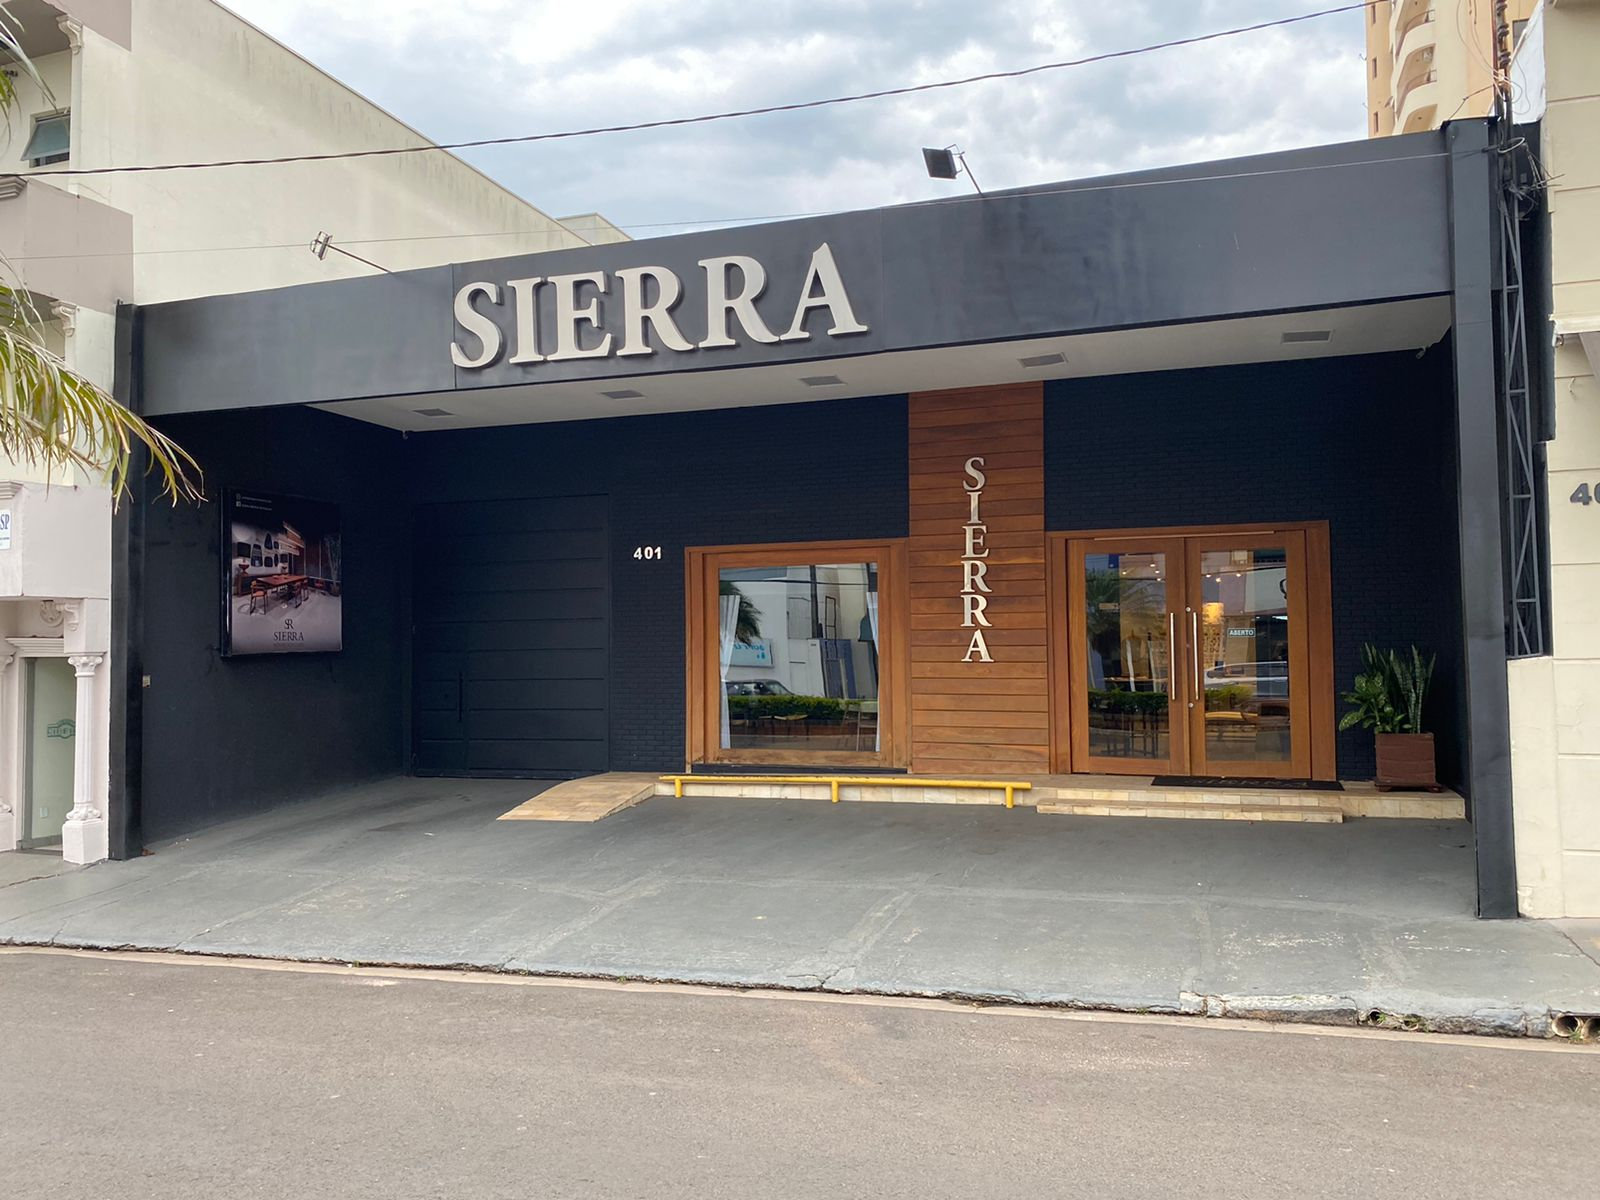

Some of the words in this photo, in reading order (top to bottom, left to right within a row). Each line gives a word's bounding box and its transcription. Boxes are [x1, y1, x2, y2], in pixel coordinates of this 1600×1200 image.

[450, 242, 868, 368] SIERRA
[633, 546, 662, 560] 401
[960, 456, 994, 662] SIERRA
[273, 631, 304, 641] SIERRA
